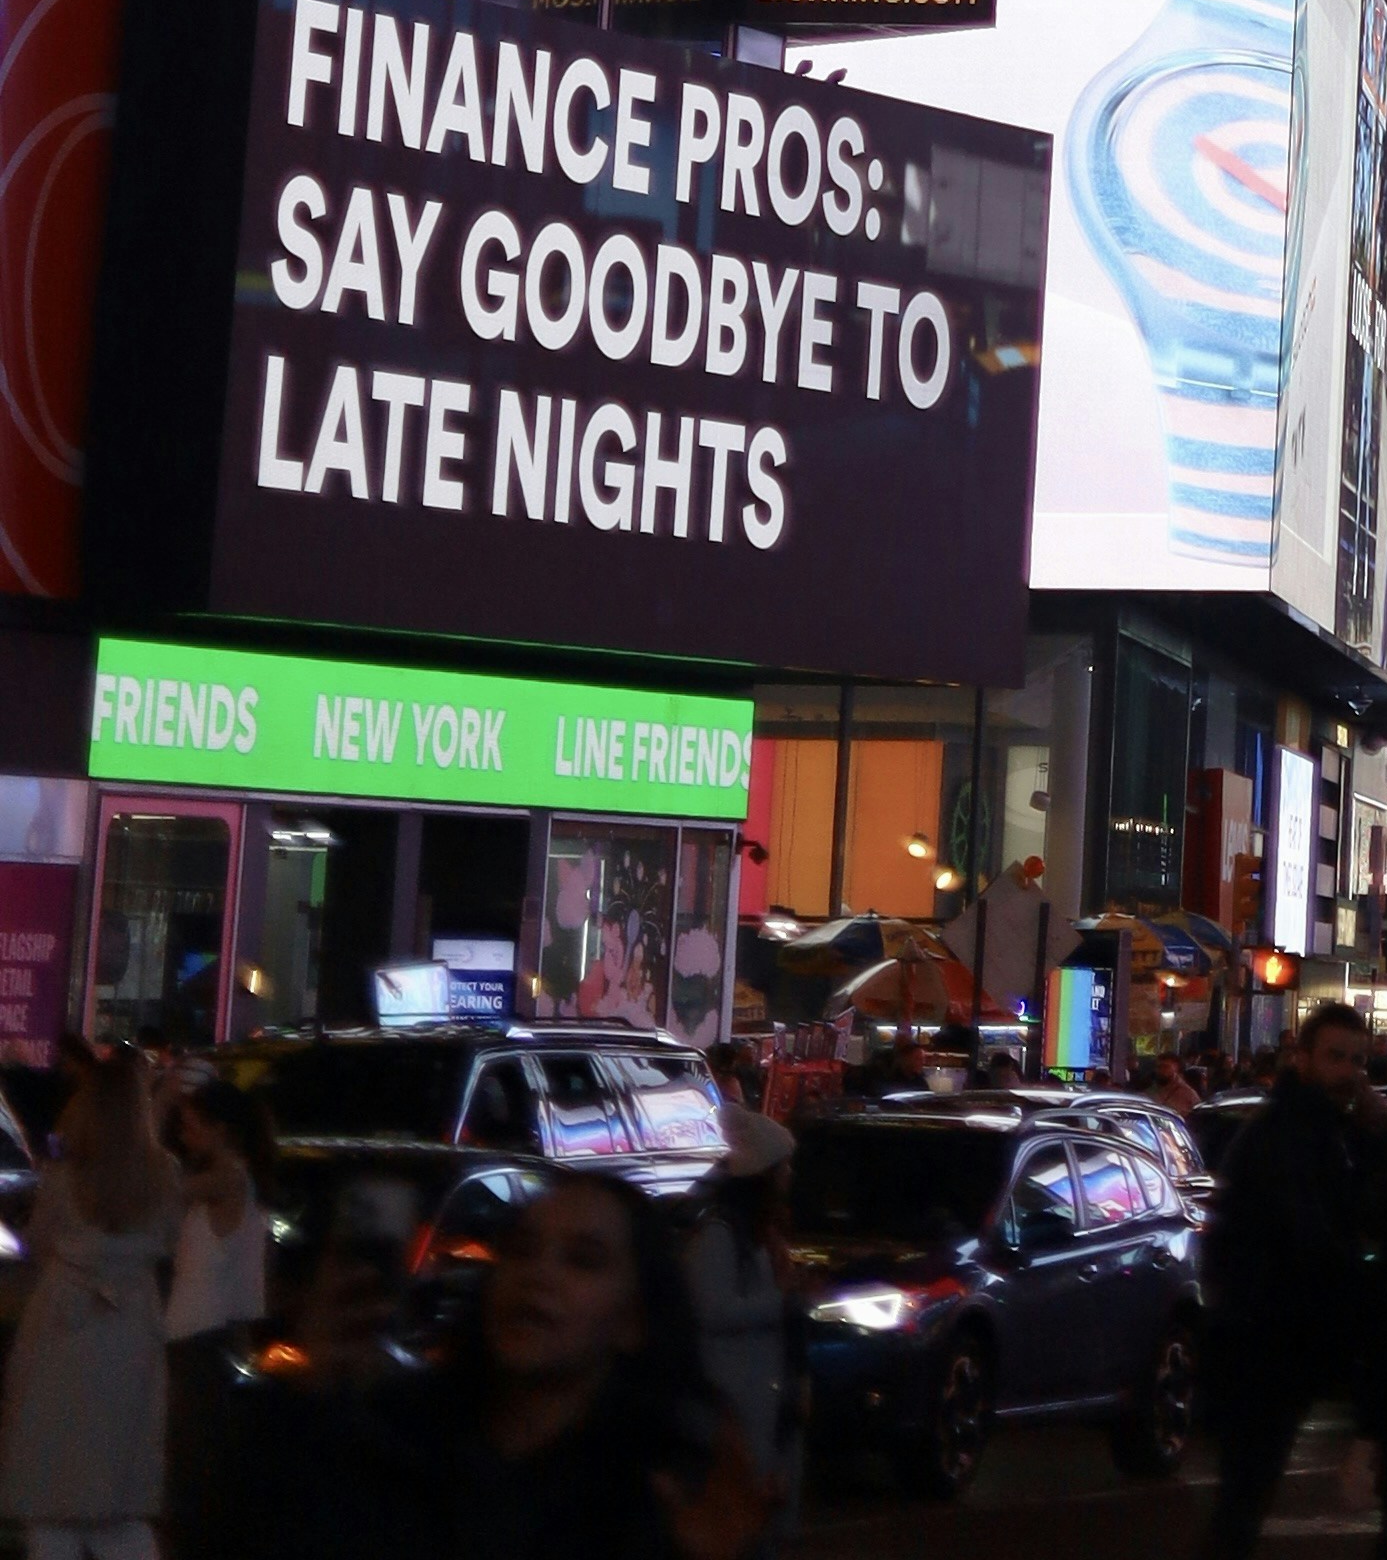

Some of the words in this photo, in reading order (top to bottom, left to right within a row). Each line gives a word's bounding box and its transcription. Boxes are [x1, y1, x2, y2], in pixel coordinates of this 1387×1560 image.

[675, 82, 884, 241] PROS:
[269, 174, 443, 326] SAY
[460, 209, 840, 393] GOODBYE
[857, 280, 951, 410] TO
[257, 353, 473, 512] LATE
[491, 388, 788, 550] NIGHTS
[91, 673, 260, 755] FRIENDS
[313, 693, 403, 764] NEW
[412, 702, 506, 772] YORK
[554, 715, 628, 781] LINE
[450, 981, 478, 991] OTECT
[480, 982, 504, 992] YOUR
[450, 995, 504, 1010] EARING
